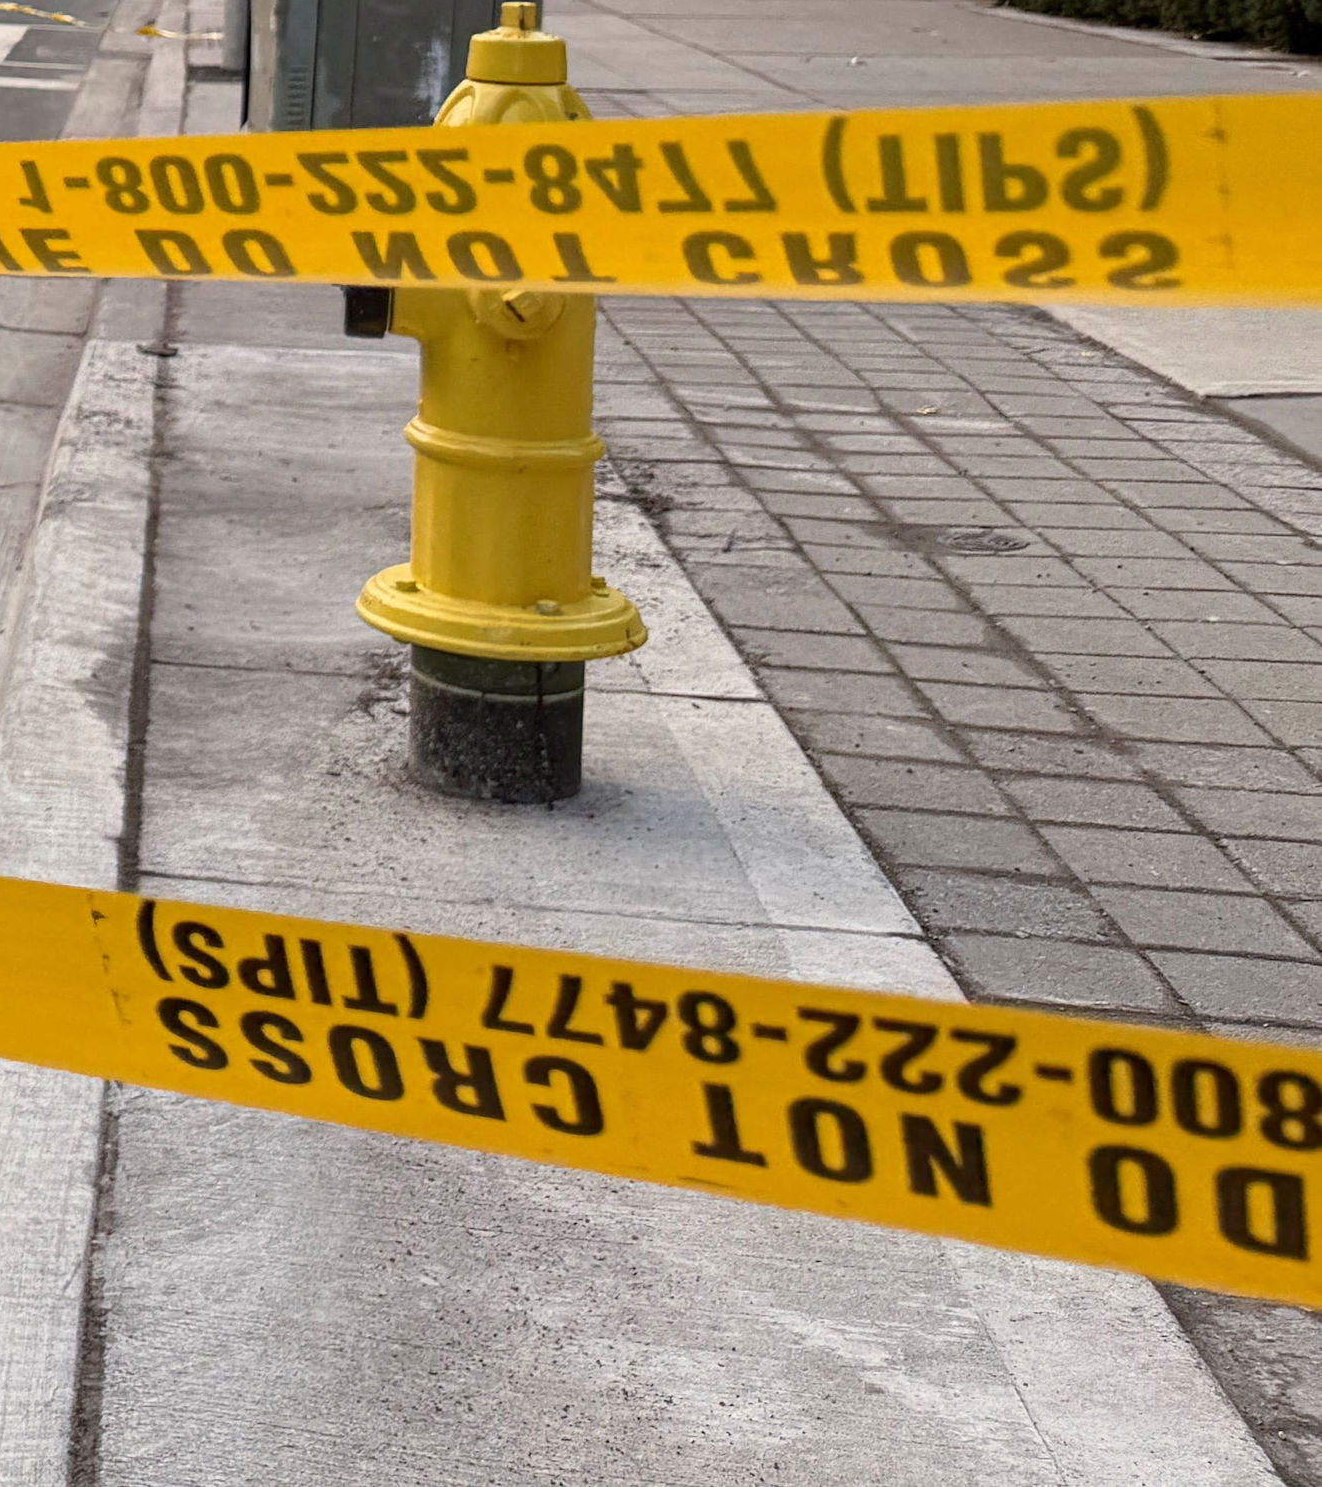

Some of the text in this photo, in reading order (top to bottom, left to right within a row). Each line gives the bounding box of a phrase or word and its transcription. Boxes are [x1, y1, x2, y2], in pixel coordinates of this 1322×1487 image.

[136, 899, 429, 1019] (TIPS)
[157, 996, 1310, 1261] DO NOT CROSS
